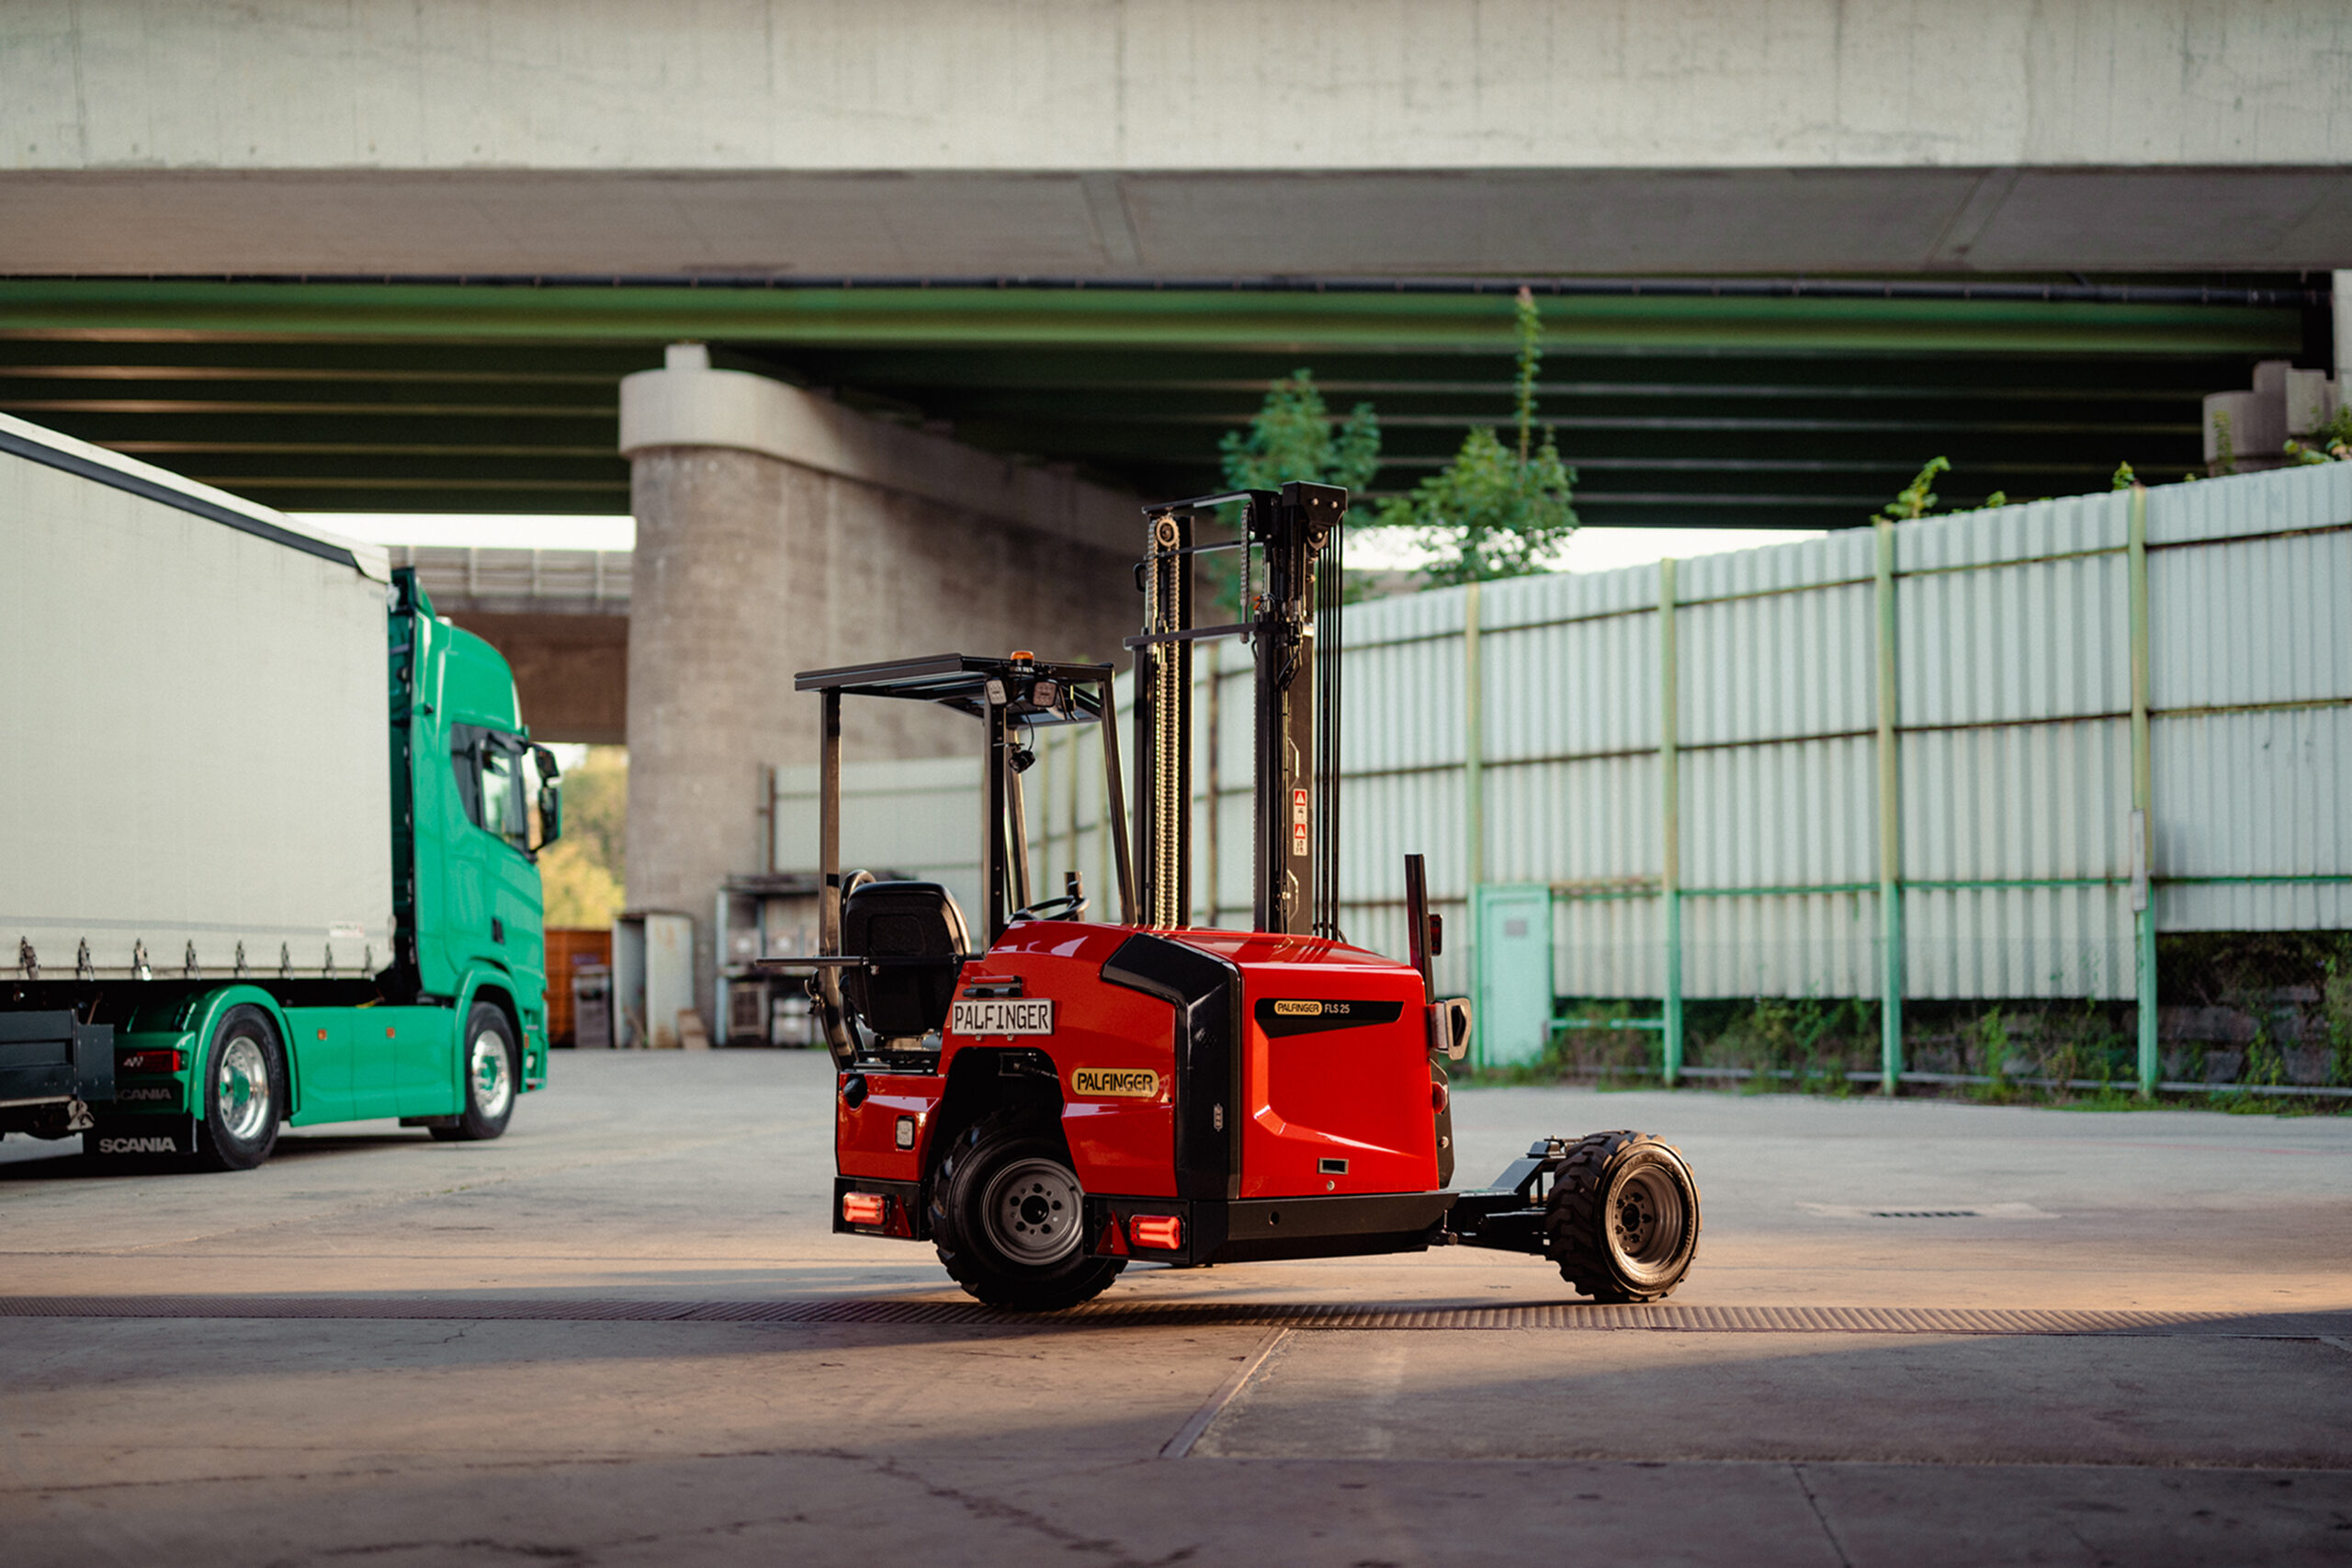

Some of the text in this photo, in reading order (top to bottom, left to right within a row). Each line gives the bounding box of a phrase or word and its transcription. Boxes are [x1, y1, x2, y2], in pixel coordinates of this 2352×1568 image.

[955, 1004, 1048, 1030] PALFINGER
[1277, 1003, 1351, 1014] PALFINGER FLS 25
[1078, 1072, 1153, 1092] PALFINGER
[98, 1136, 177, 1154] SCANIA
